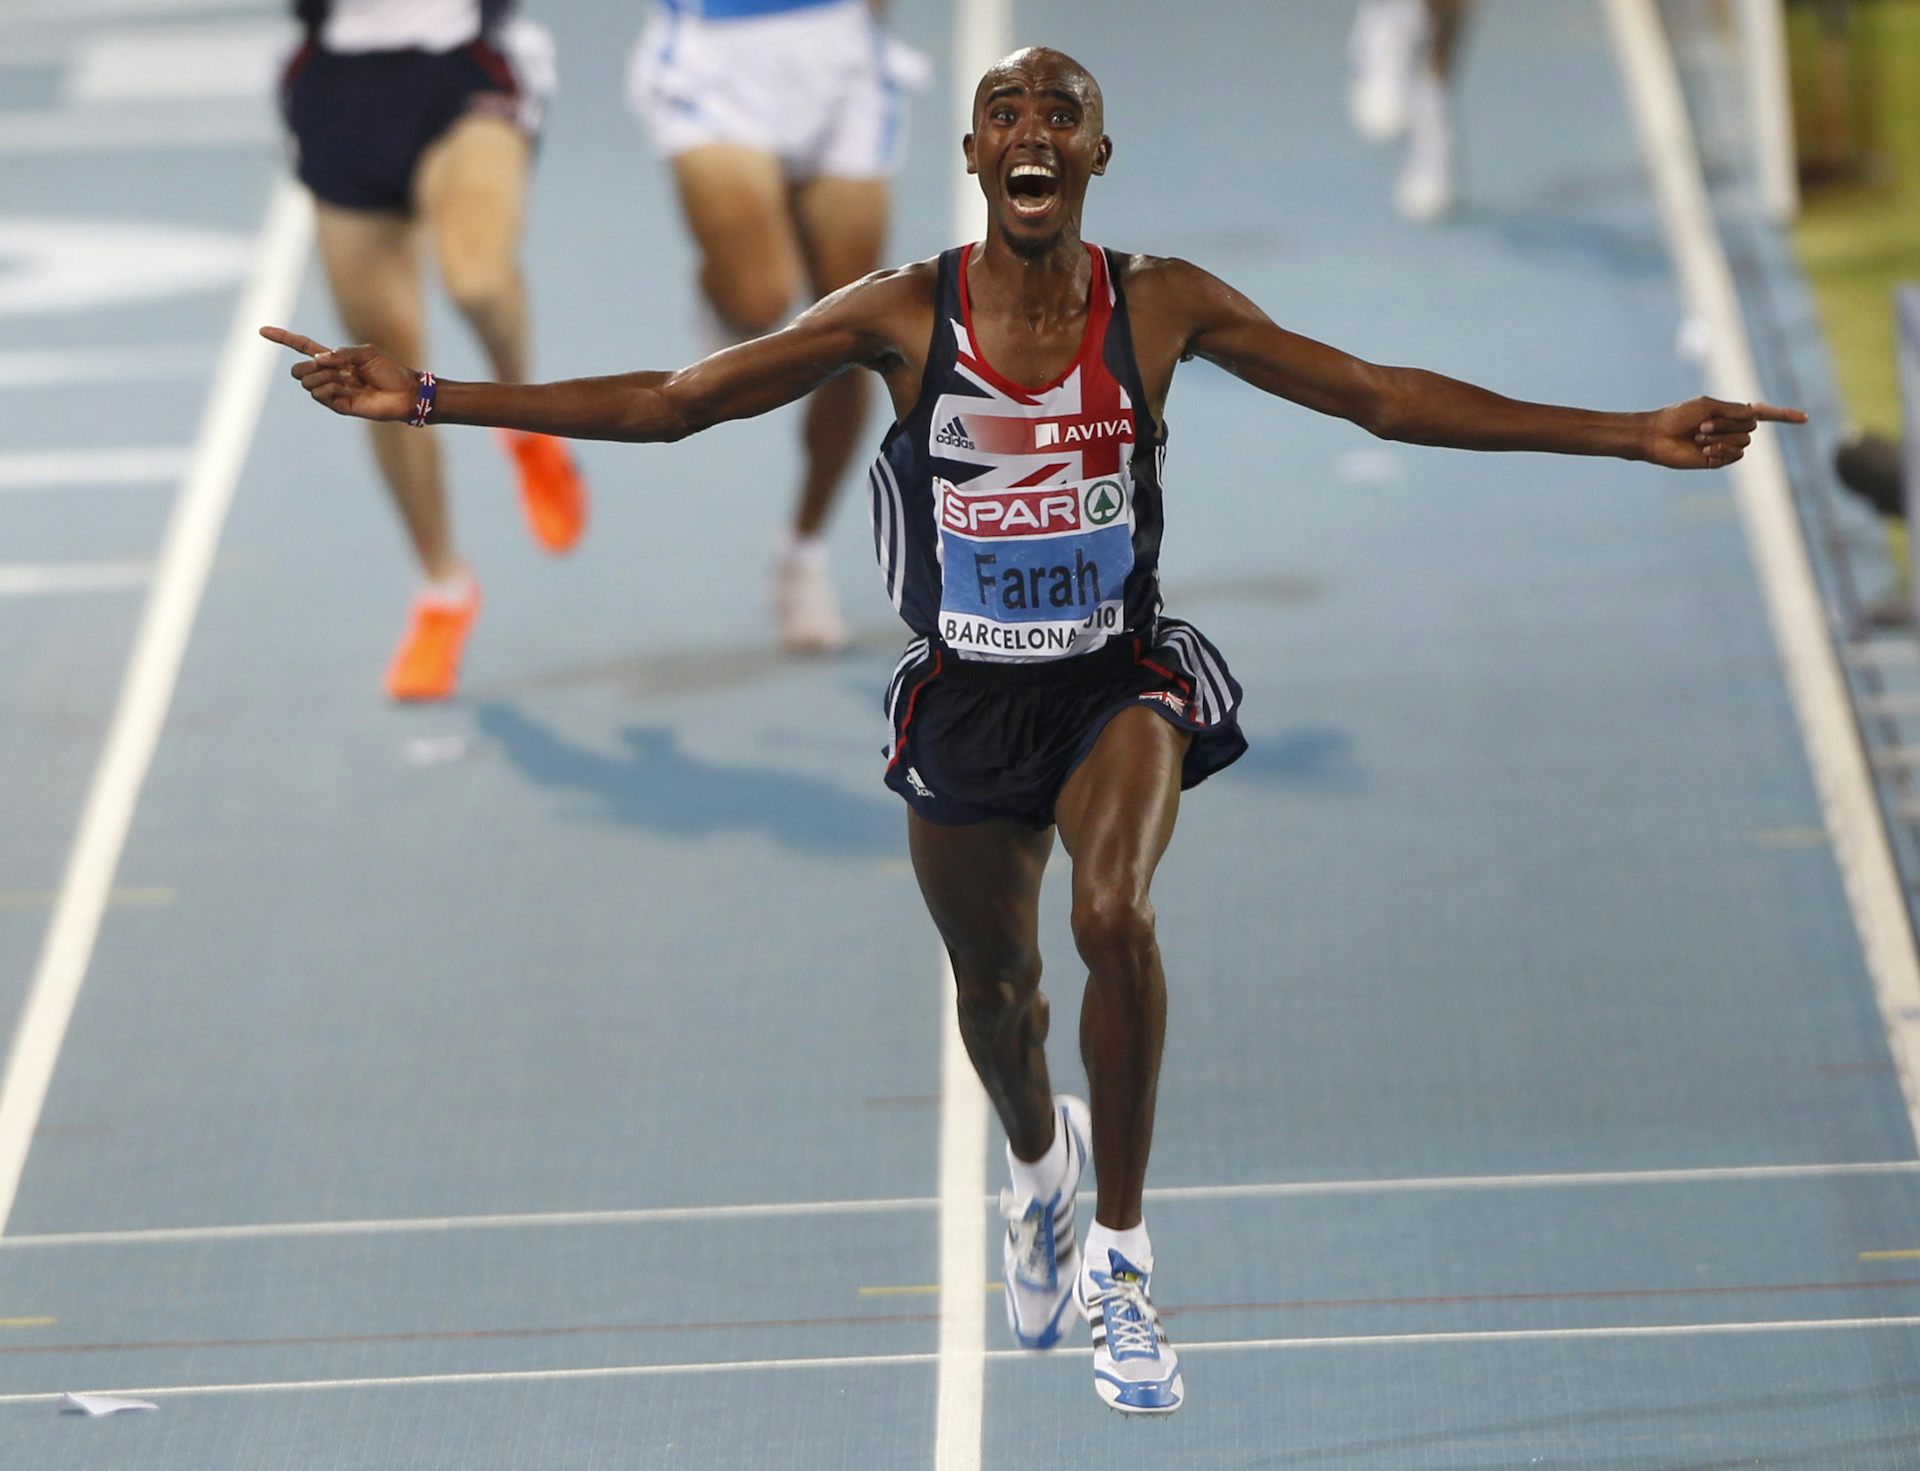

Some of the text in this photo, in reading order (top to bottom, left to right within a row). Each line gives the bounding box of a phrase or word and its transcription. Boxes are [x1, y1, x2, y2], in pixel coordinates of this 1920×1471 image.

[936, 433, 976, 450] adidas
[1064, 418, 1133, 443] AVIVA
[944, 495, 1077, 531] SPAR
[974, 548, 1100, 610] Farah
[945, 619, 1077, 650] BARCELONA
